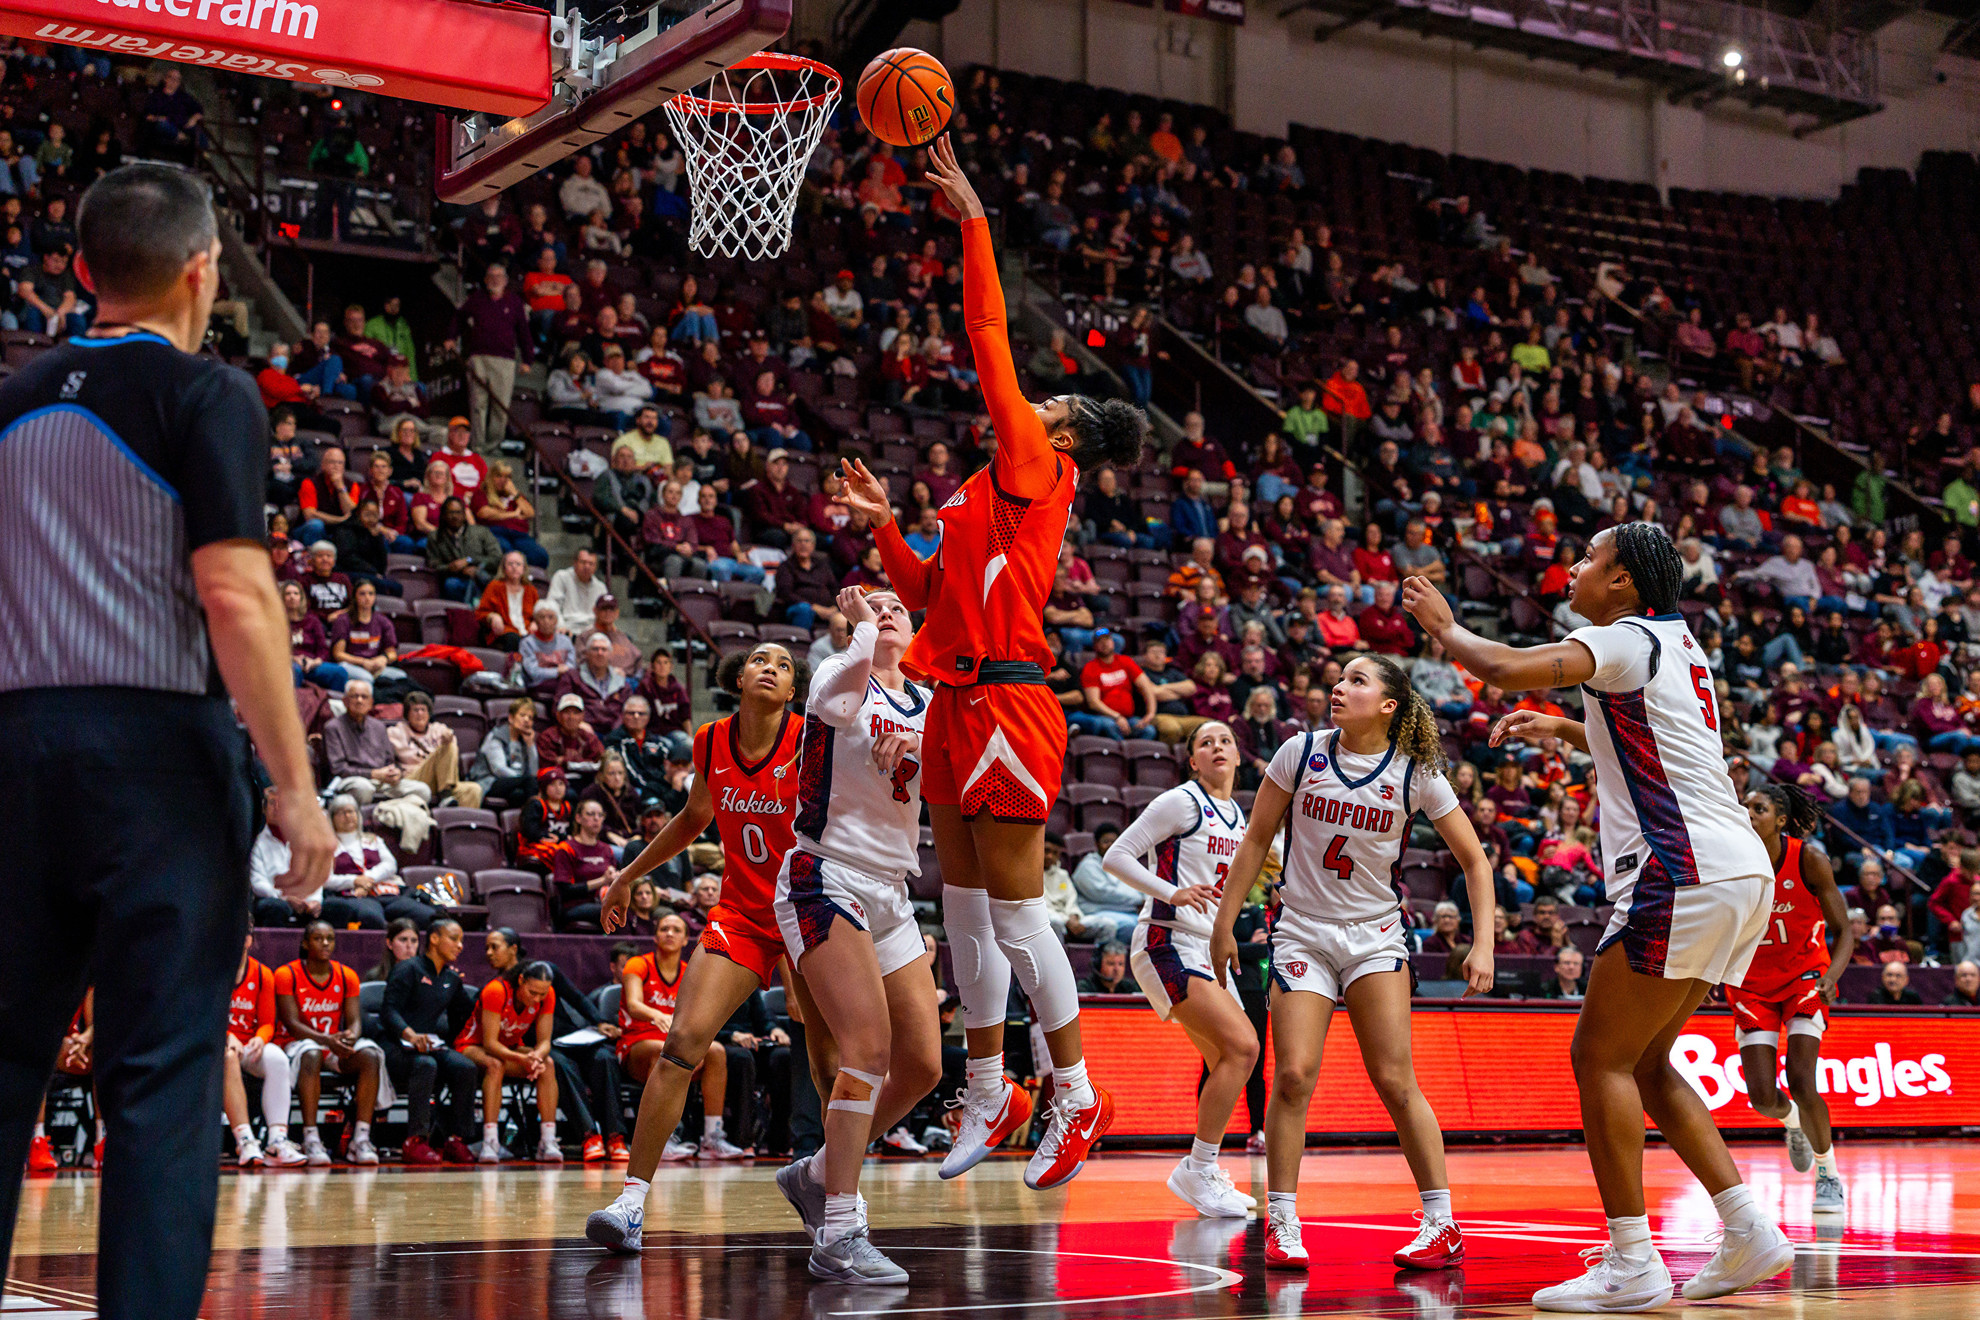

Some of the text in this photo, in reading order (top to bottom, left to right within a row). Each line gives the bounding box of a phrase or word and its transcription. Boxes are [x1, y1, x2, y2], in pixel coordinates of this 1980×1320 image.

[35, 23, 309, 79] State Farm
[1690, 663, 1717, 732] 5
[1314, 755, 1325, 763] VA
[720, 786, 787, 815] Hokies
[1302, 793, 1394, 833] RADFORD
[742, 823, 769, 865] 0
[1207, 835, 1239, 857] RADF
[1323, 834, 1354, 880] 4
[1212, 862, 1229, 899] 2
[1771, 900, 1795, 914] ies
[1669, 1034, 1951, 1111] Bongles
